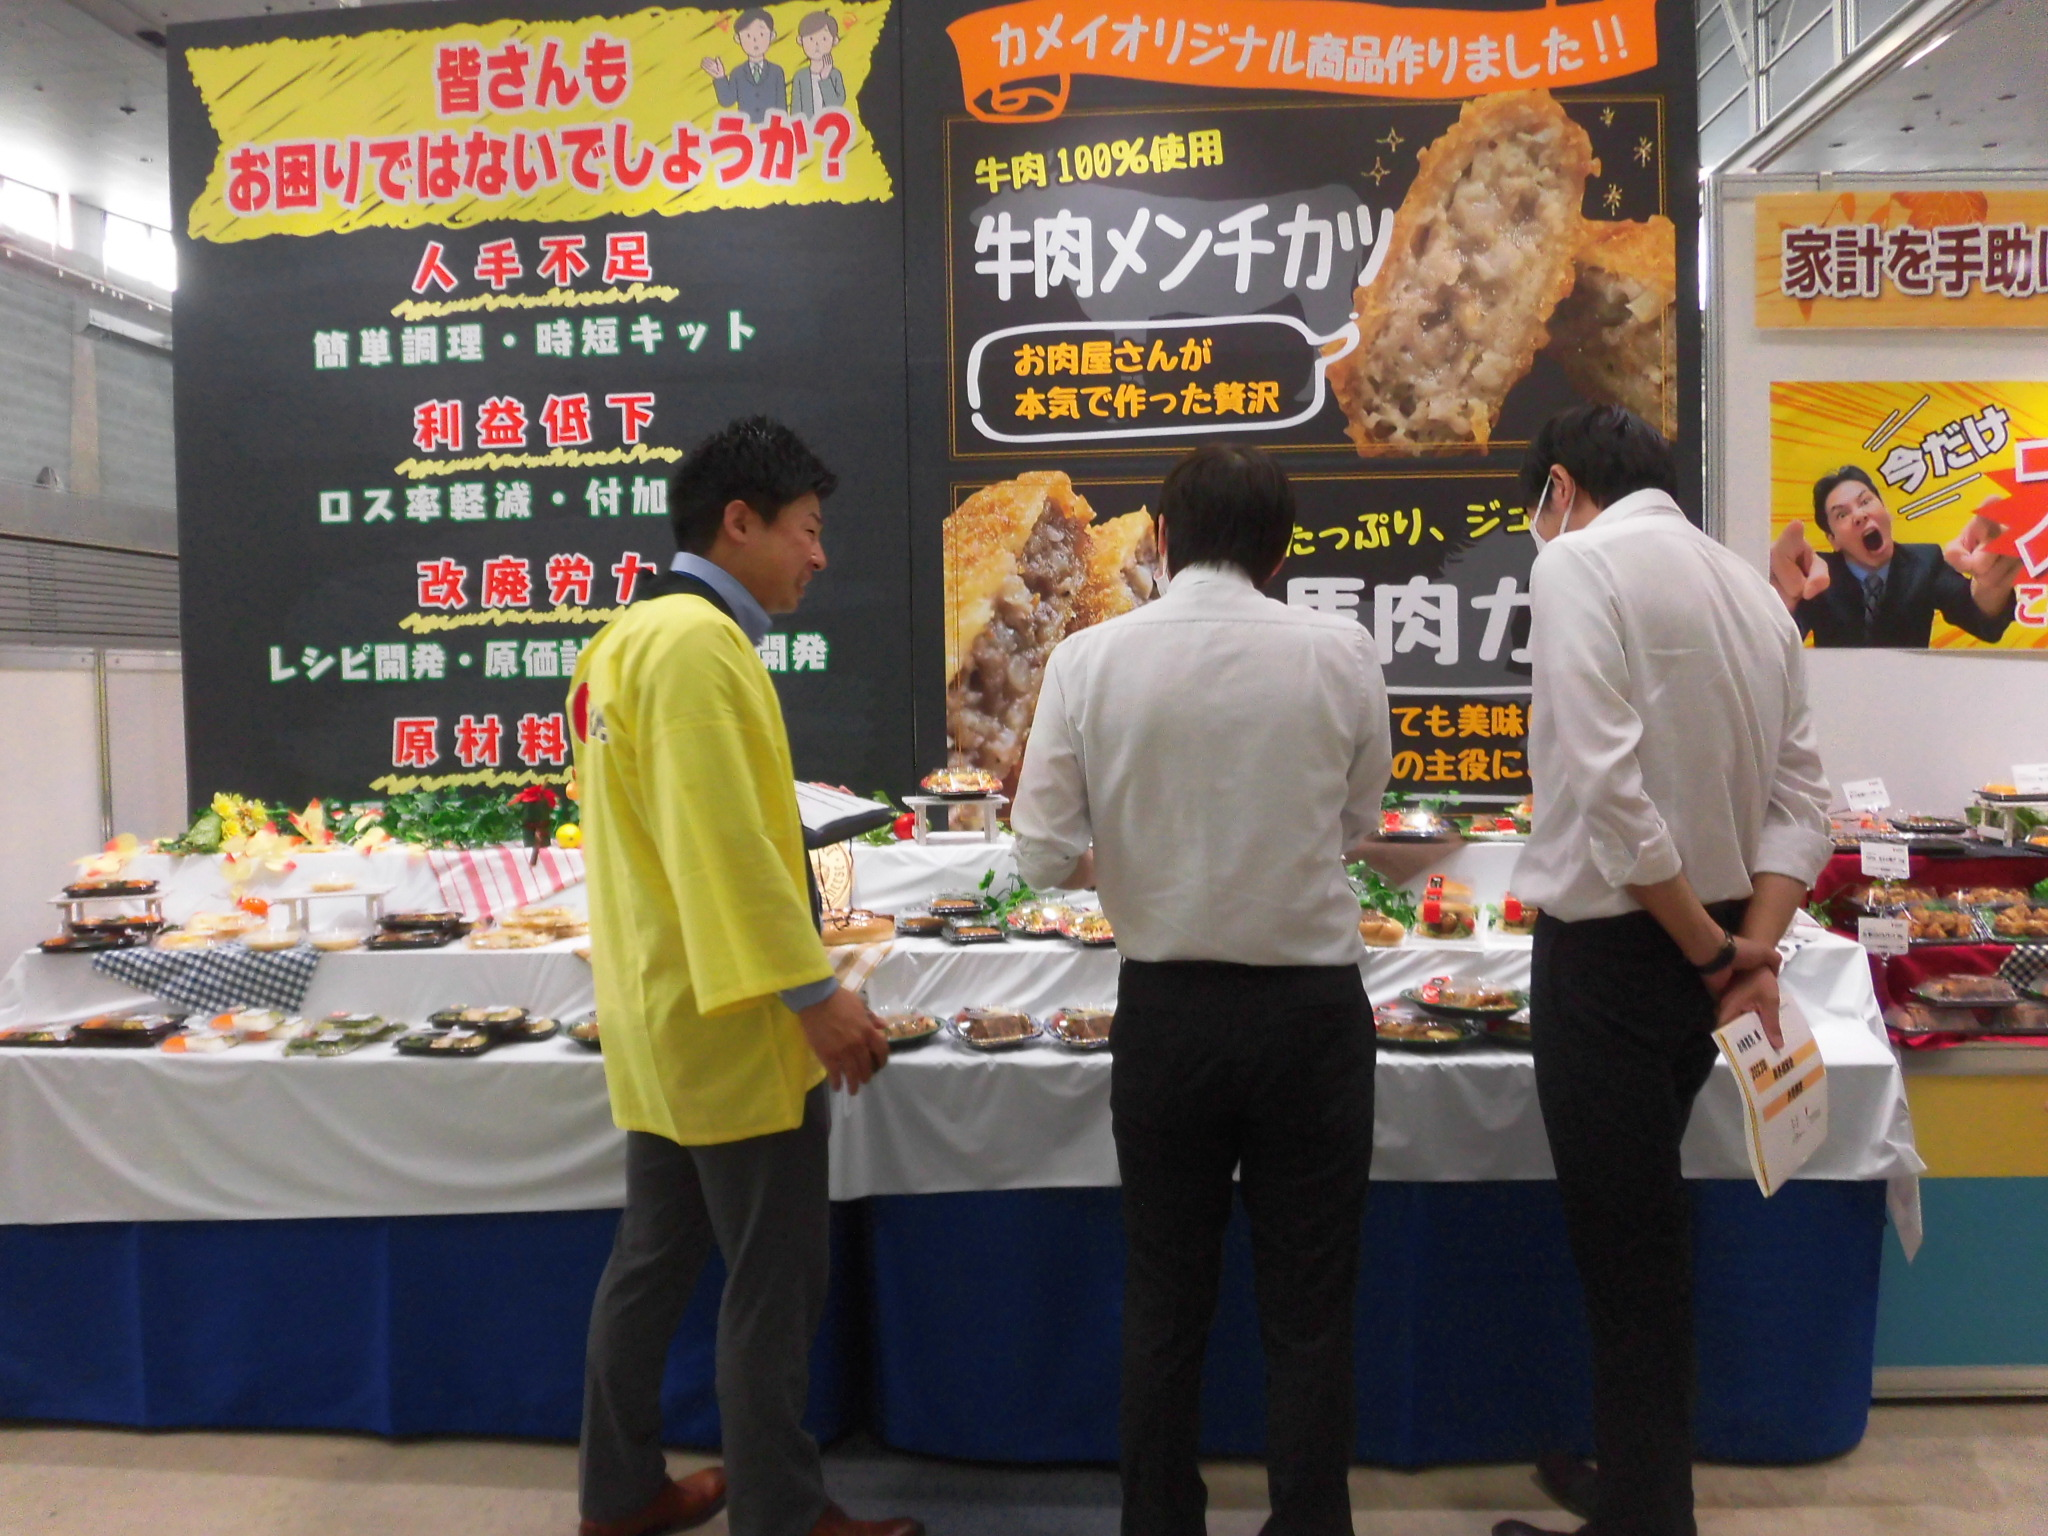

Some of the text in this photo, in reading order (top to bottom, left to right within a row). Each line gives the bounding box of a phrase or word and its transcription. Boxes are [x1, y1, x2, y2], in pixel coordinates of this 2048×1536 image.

[437, 38, 627, 113] 皆さんも
[992, 15, 1627, 86] カメイオリジナル商品作りました!!
[227, 112, 852, 212] お困りではないでしょうか？
[411, 232, 653, 293] 人手不足
[974, 203, 1394, 301] 牛肉メンチカツ
[1784, 226, 2048, 296] 家計を手助
[313, 311, 755, 369] 簡単調理・時短キット
[1014, 338, 1212, 376] お肉屋さんが
[413, 392, 656, 452] 利益低下
[1014, 380, 1280, 421] 本気で作った贅沢
[1878, 404, 2010, 494] 今だけ
[392, 715, 567, 766] 原材料
[1391, 704, 1532, 738] ても美味
